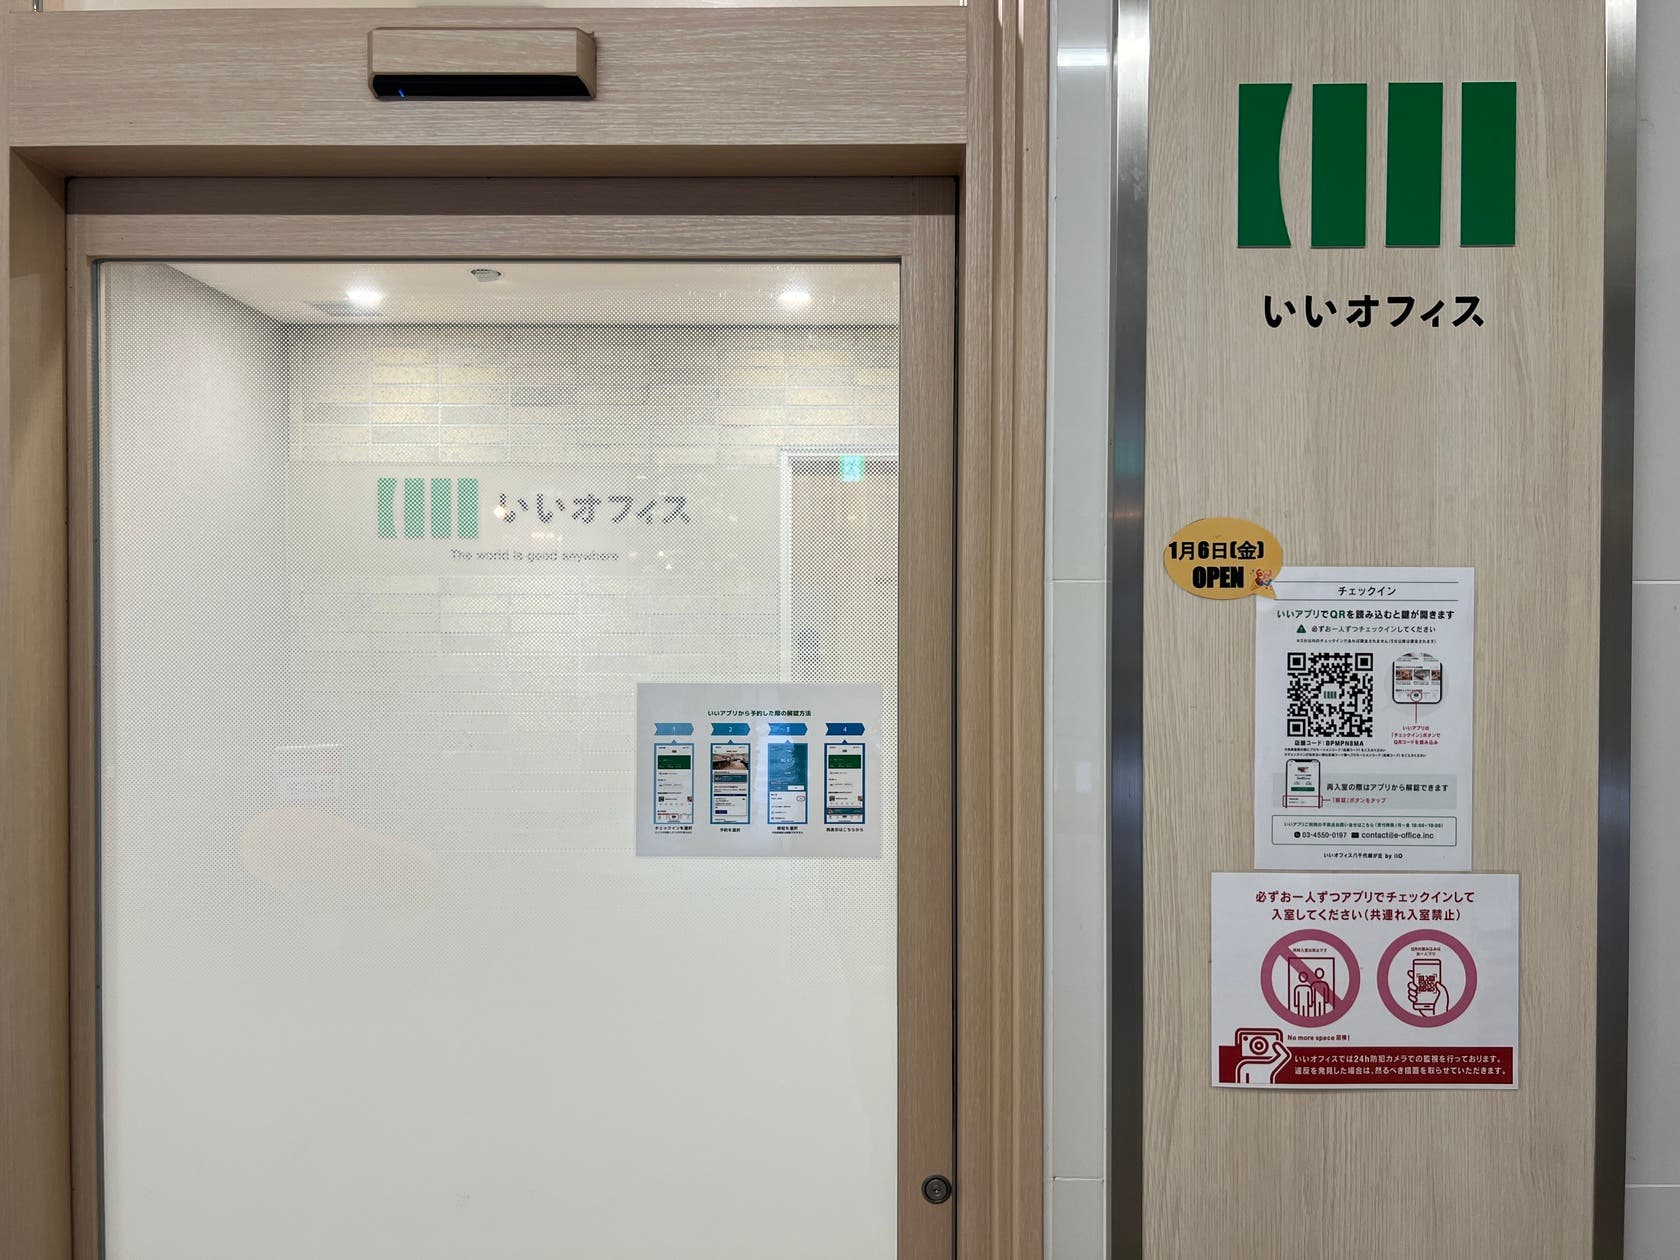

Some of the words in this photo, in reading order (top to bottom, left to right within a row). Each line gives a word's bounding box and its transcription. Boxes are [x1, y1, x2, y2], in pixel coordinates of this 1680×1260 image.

[1265, 295, 1484, 328] いいオフィス
[497, 493, 691, 524] いいオフィス
[451, 549, 473, 561] The
[476, 550, 509, 561] world
[513, 550, 523, 561] is
[527, 552, 558, 563] good
[561, 552, 619, 563] anywhere
[1193, 567, 1243, 588] OPEN
[1337, 586, 1397, 597] チェックイン
[1276, 608, 1455, 620] いいアプリでQRを読み込むと鍵が開きます
[1311, 625, 1436, 634] 必ずお一人ずつチェックインしてください
[1326, 783, 1449, 792] 再入室の際はアプリから解錠できます
[1301, 831, 1348, 839] 03-4550-0197
[1361, 831, 1434, 840] contact@e-office.inc
[1255, 890, 1475, 904] 必ずお一人ずつアプリでチェックインして
[1294, 1054, 1501, 1064] いいオフィスでは24h防犯カメラでの監視を行っております。
